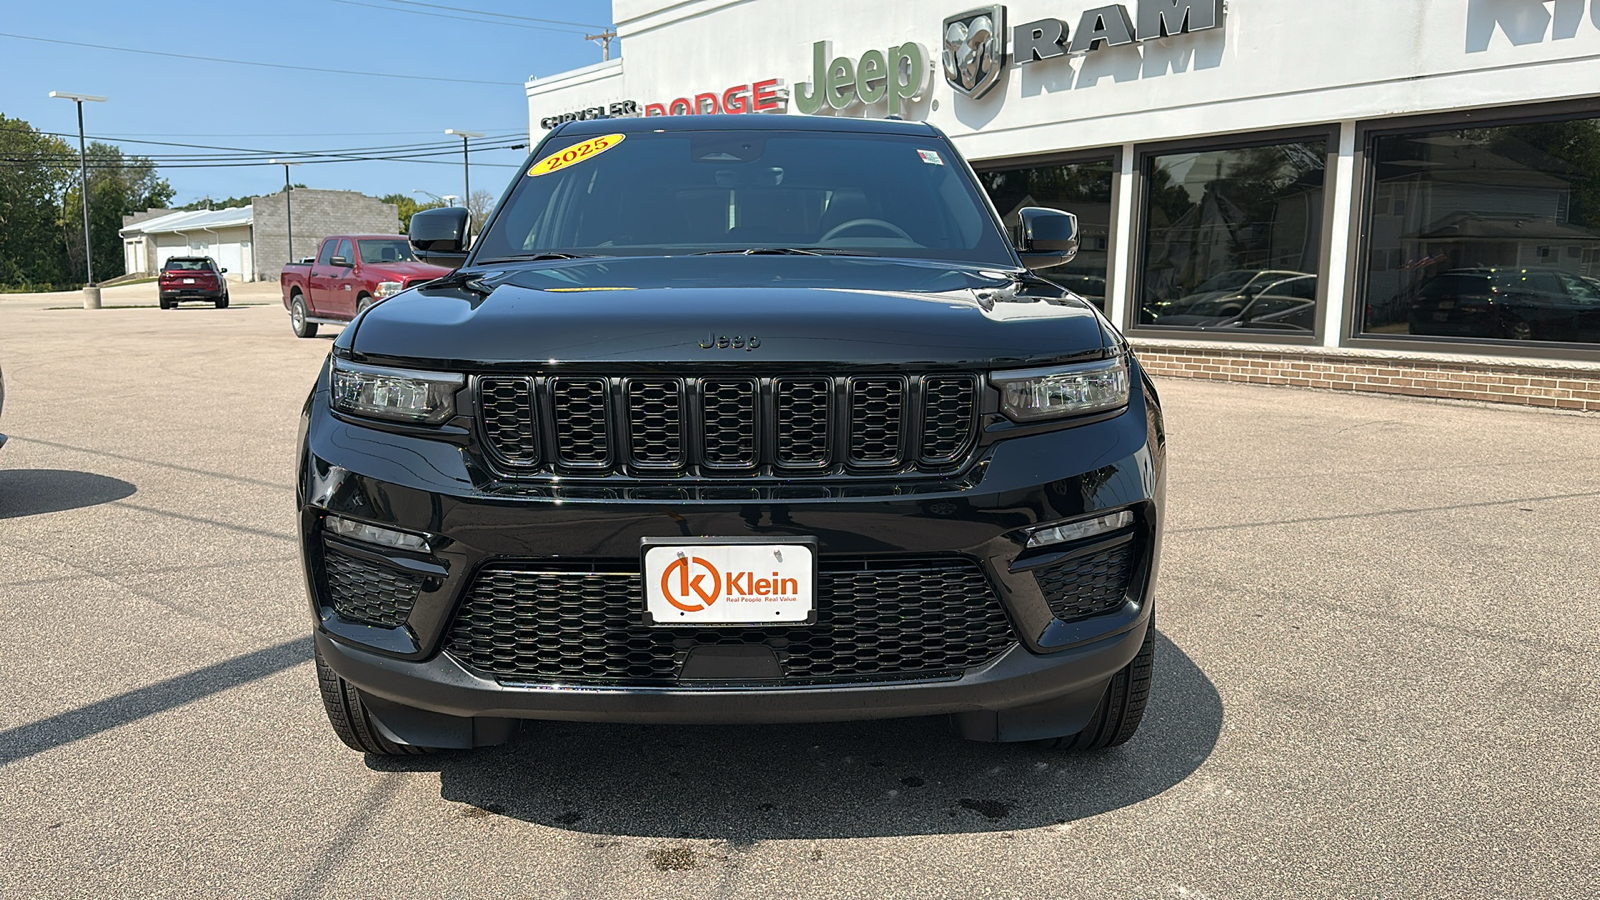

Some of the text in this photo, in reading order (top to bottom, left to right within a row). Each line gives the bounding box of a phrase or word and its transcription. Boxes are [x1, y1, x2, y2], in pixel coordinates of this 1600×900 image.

[1013, 0, 1222, 65] RAM
[794, 40, 929, 115] Jeep
[645, 78, 782, 117] DODGE
[547, 137, 609, 171] 2025
[698, 332, 761, 352] Jeep
[726, 572, 798, 596] Klein
